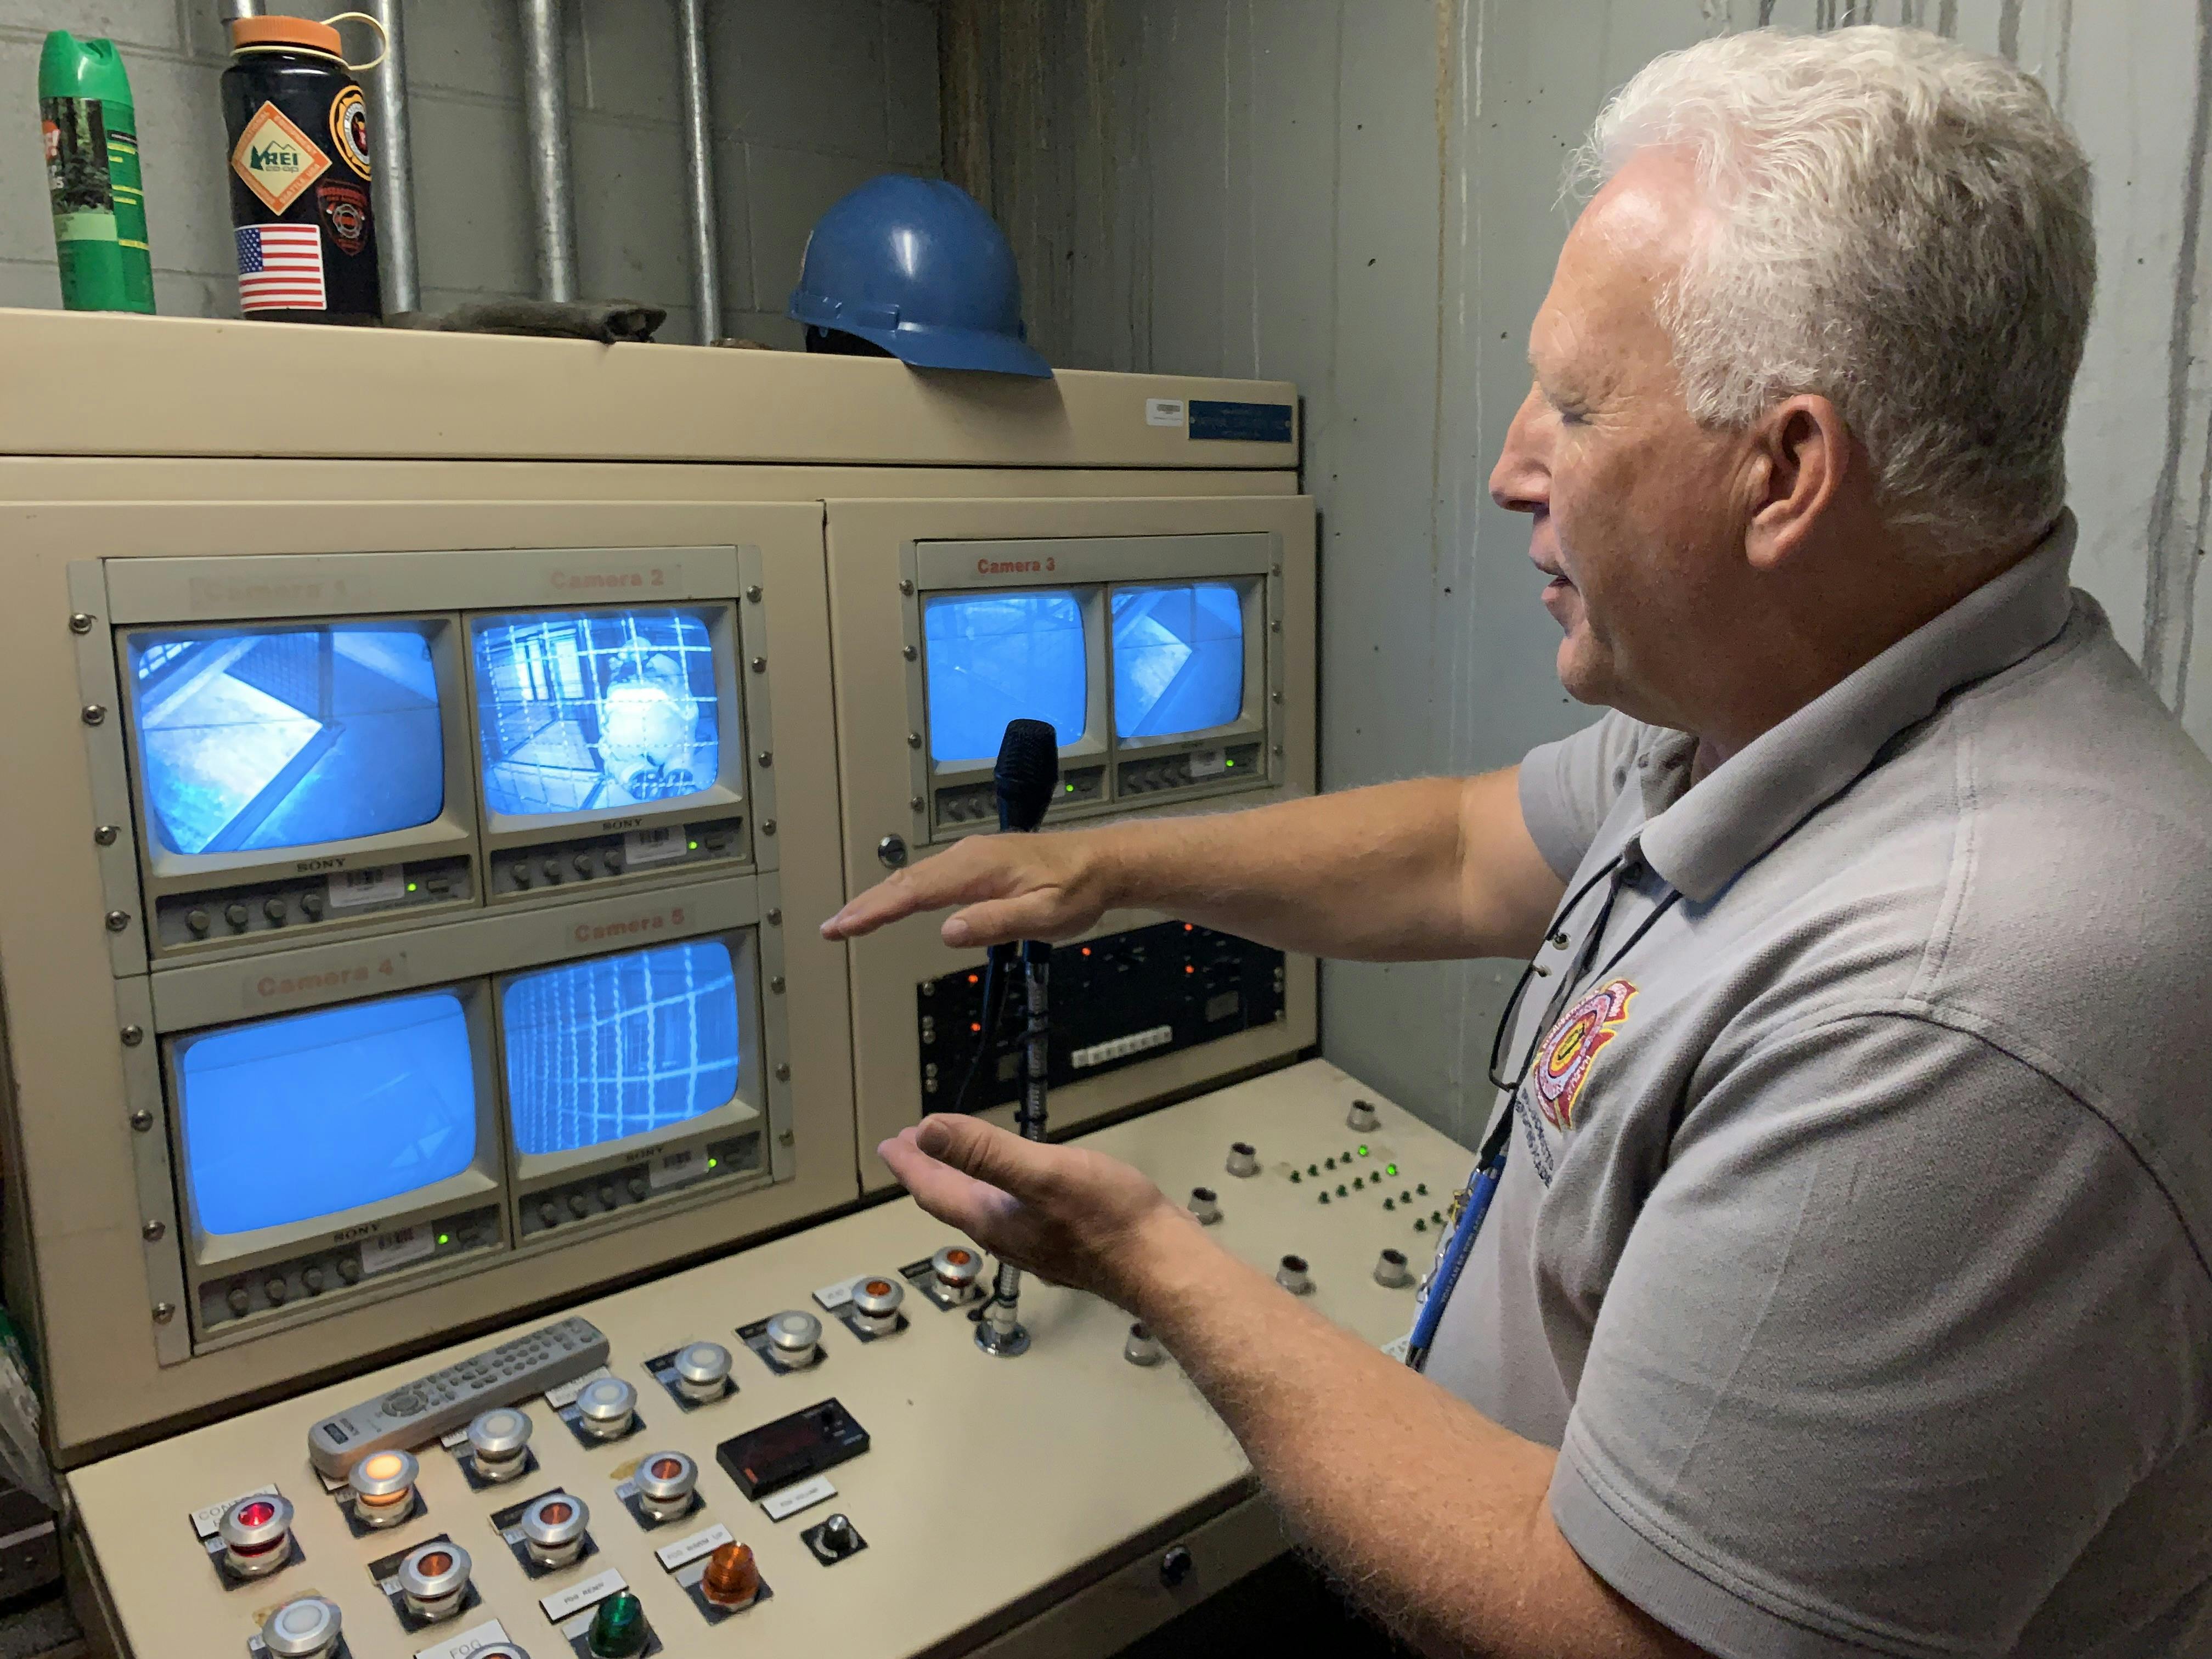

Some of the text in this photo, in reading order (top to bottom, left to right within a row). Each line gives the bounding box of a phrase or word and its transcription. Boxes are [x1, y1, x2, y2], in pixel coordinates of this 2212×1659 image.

[265, 153, 298, 165] REI
[978, 557, 1056, 574] Camera 3
[550, 569, 664, 589] Camera 2
[603, 819, 642, 831] SONY
[297, 857, 346, 872] SONY
[574, 915, 663, 942] Camera
[257, 966, 369, 997] Camera
